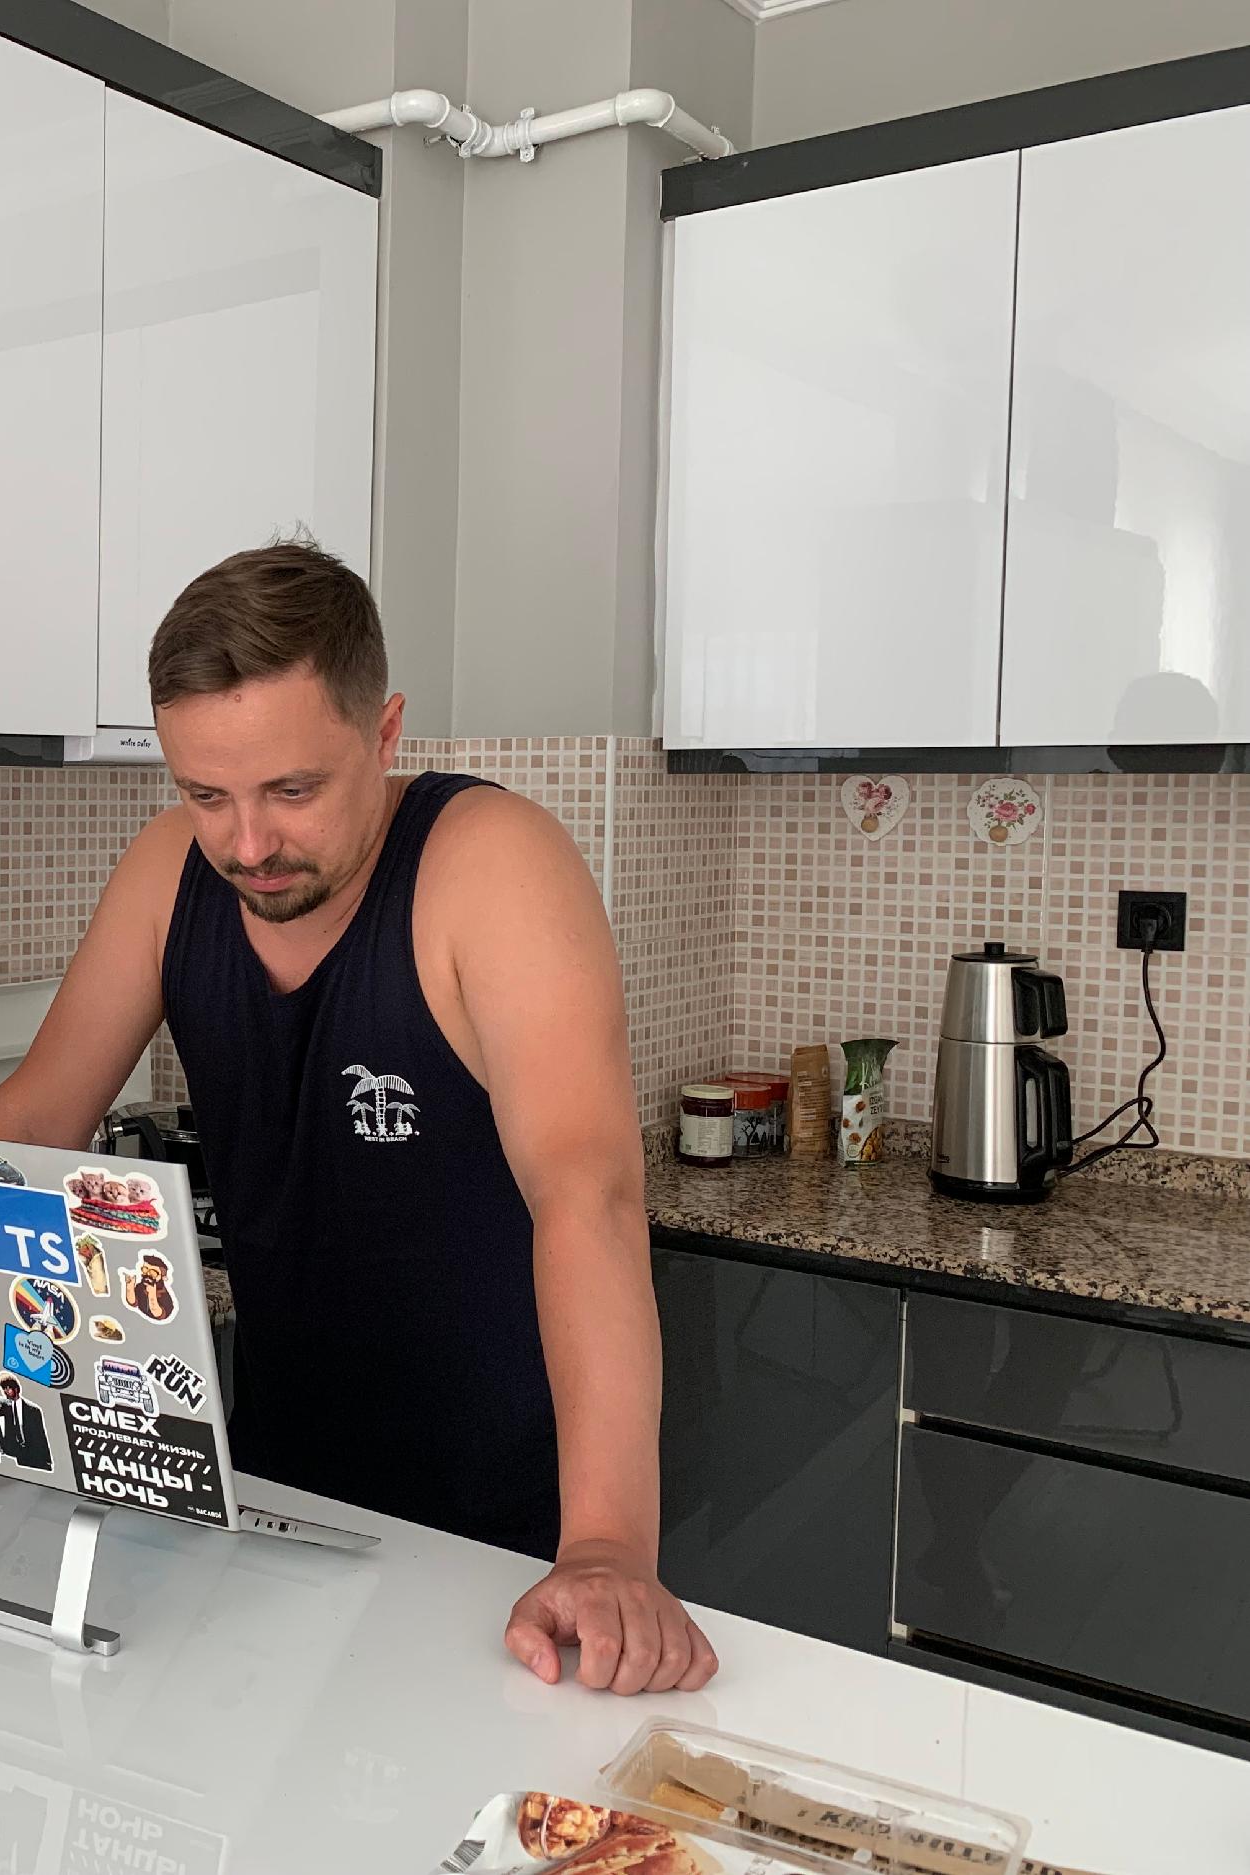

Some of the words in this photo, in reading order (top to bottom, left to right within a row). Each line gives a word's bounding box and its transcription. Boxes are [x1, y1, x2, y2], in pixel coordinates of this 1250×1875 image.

[3, 1224, 70, 1275] TS
[33, 1279, 65, 1304] NASA
[147, 1358, 204, 1411] RUN
[164, 1356, 203, 1388] JUST
[68, 1401, 161, 1438] СМЕХ
[73, 1424, 155, 1449] ПРОДЛЕВАЕТ
[158, 1442, 206, 1460] ЖИЗНЬ
[77, 1450, 194, 1493] ТАНЦЫ
[81, 1473, 169, 1509] НОЧЬ
